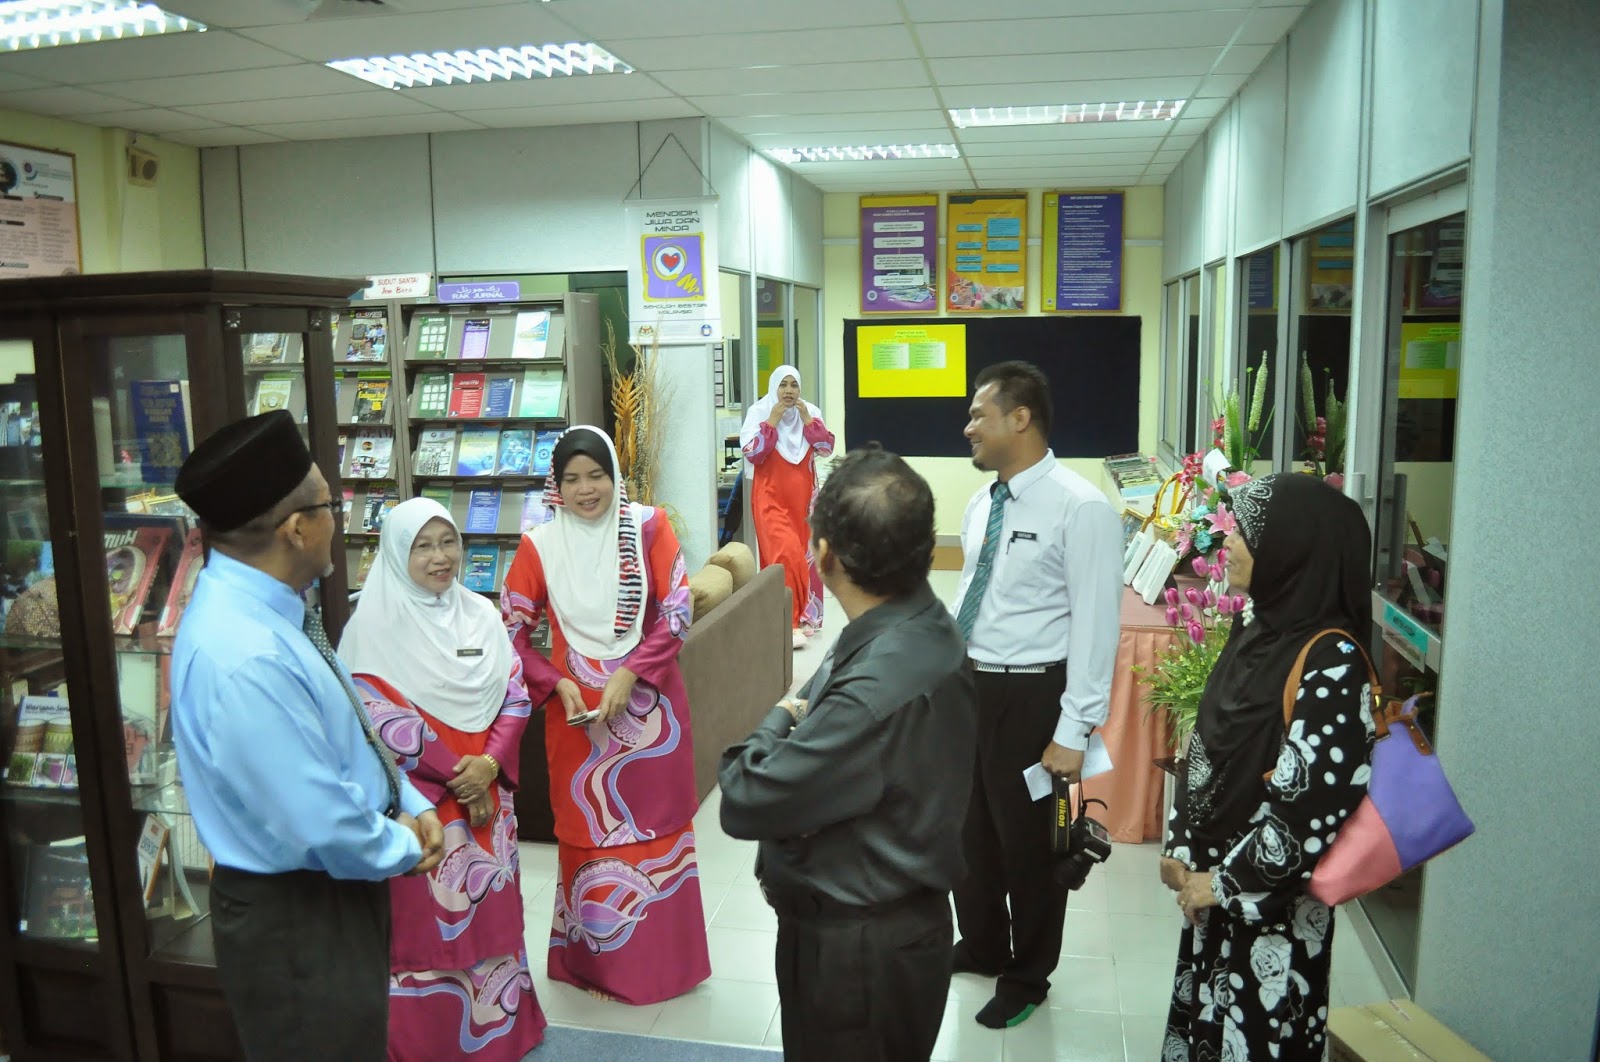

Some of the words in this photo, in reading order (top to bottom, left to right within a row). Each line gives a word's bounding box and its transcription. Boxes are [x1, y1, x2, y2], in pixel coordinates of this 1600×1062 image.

[646, 210, 699, 218] MENDIDIK
[378, 278, 397, 286] SUDUT
[1058, 798, 1067, 828] Nikon
